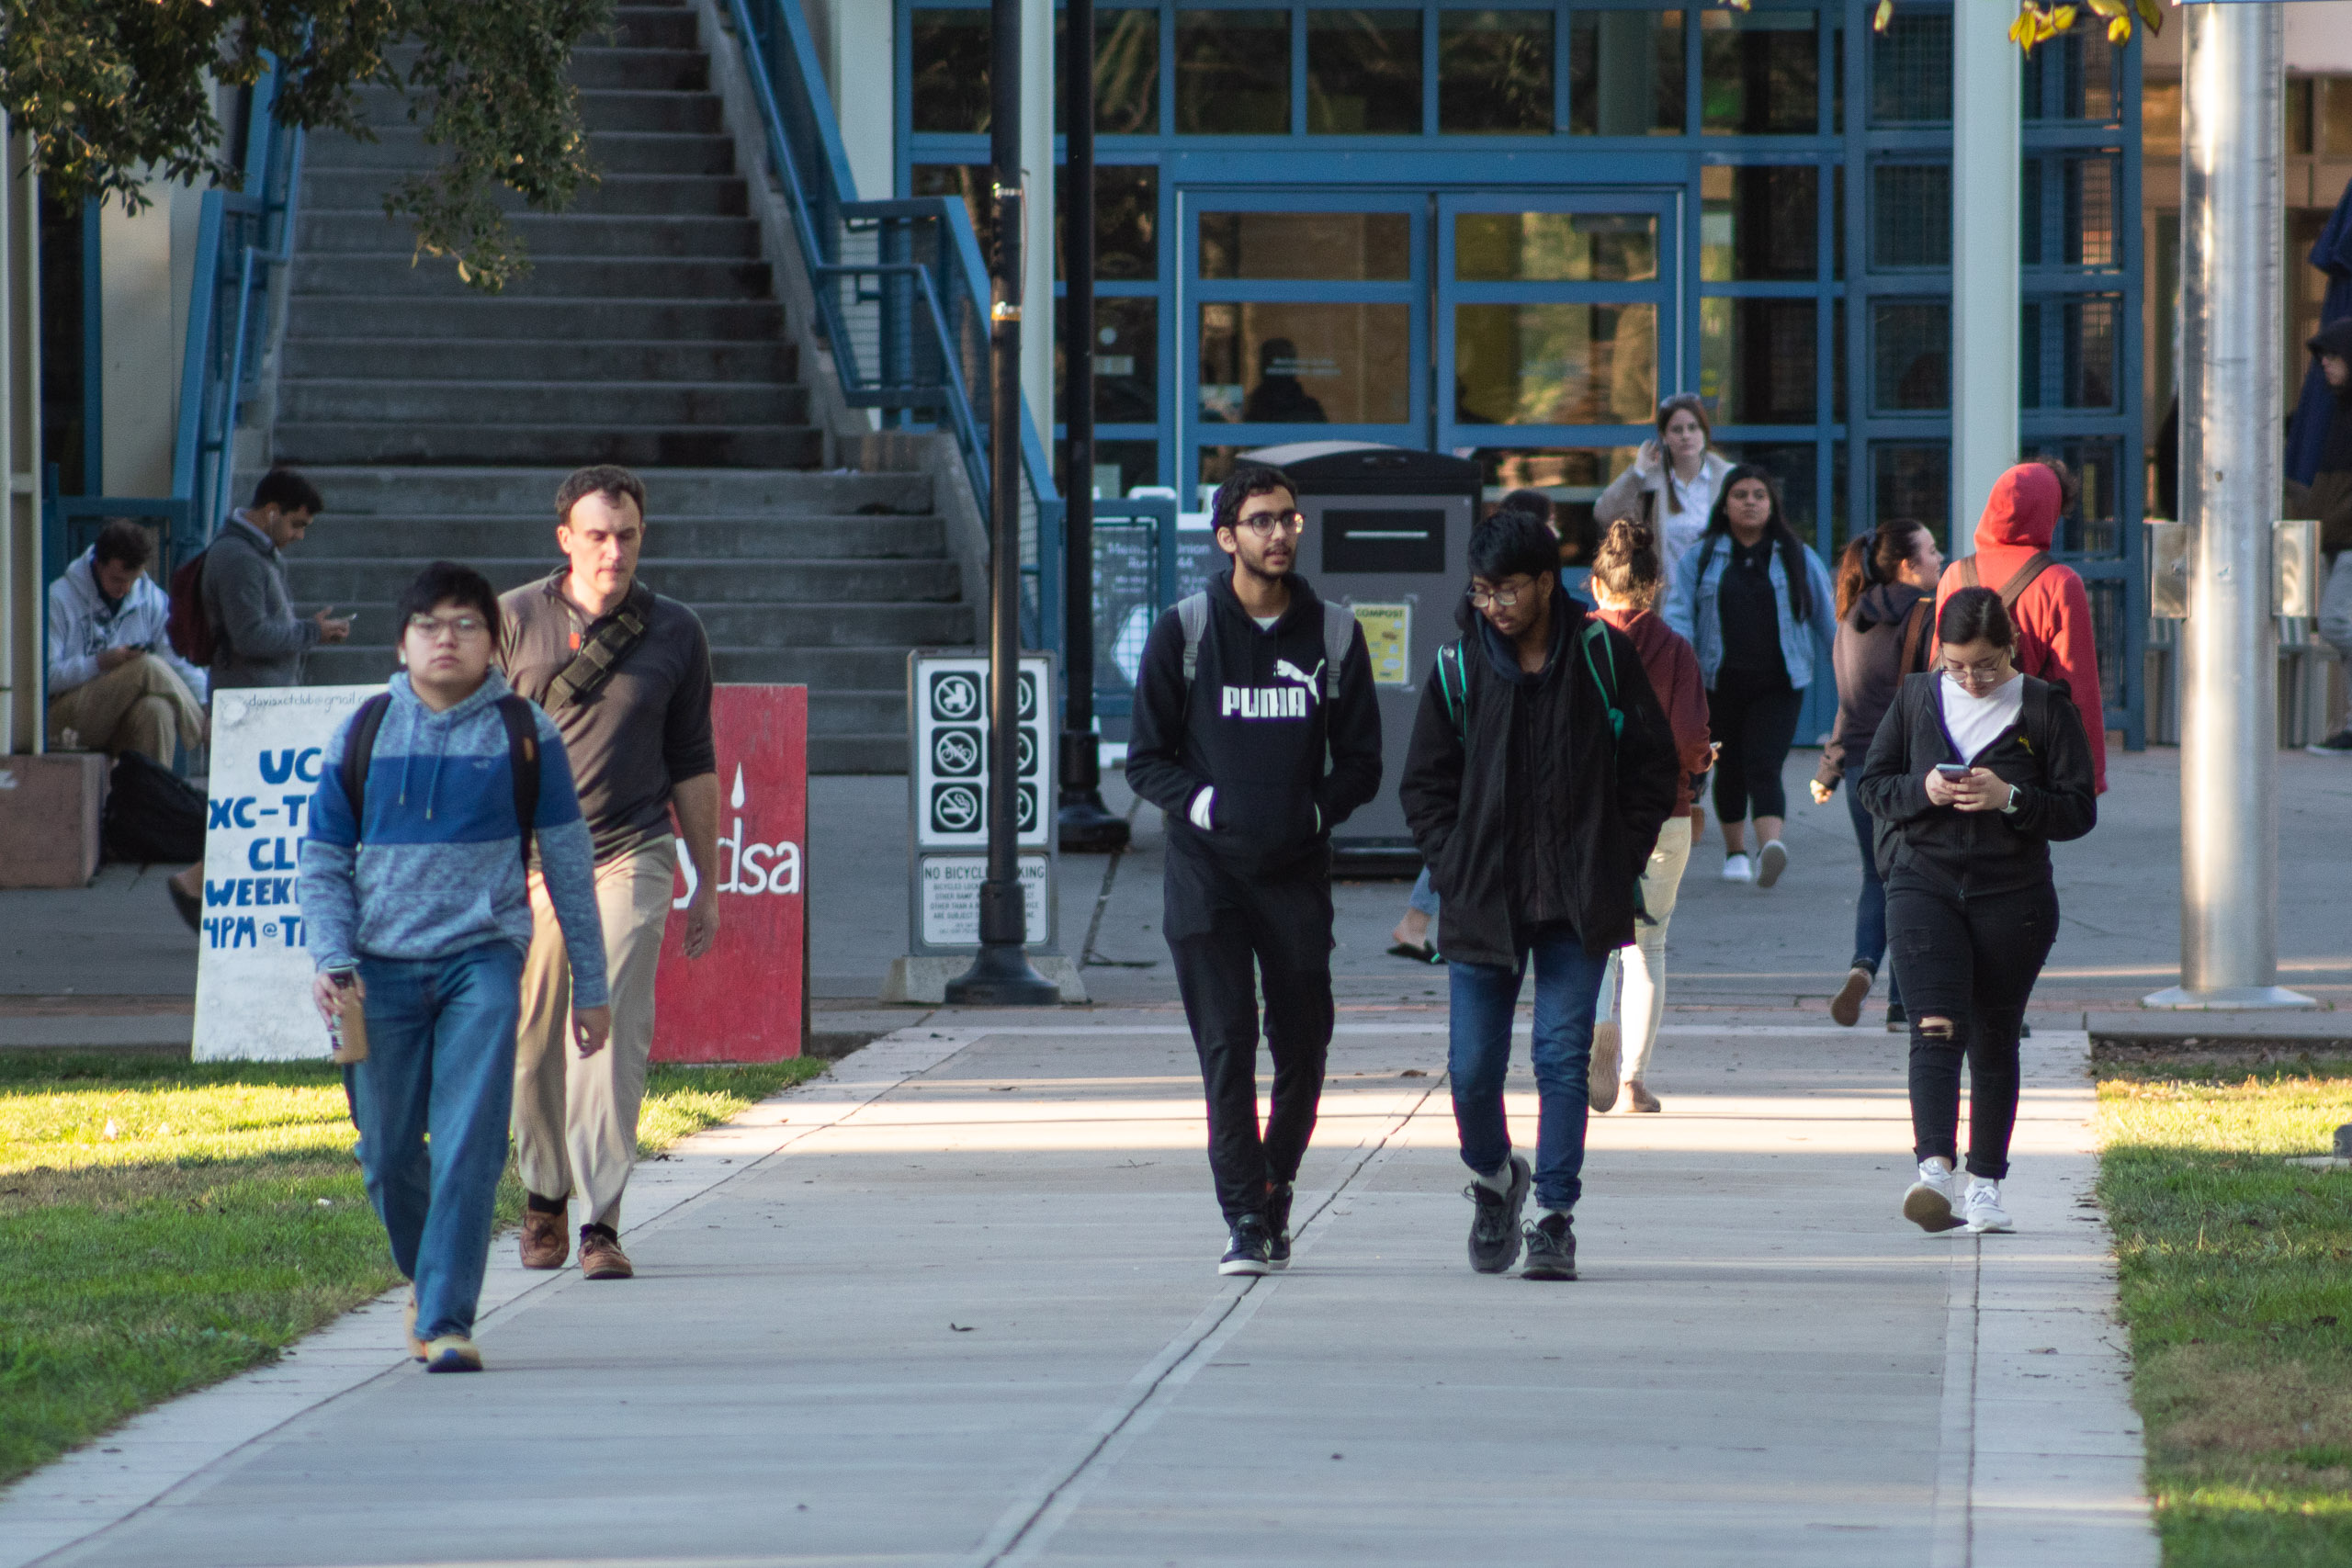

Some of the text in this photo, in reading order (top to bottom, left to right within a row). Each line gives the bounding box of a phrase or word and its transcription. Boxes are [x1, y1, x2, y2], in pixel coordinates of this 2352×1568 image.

[1355, 609, 1404, 618] COMPOST
[1222, 685, 1306, 717] PUMA
[259, 747, 322, 784] UC
[208, 795, 310, 829] XC-T
[924, 866, 941, 880] NO
[1018, 866, 1045, 879] KING
[205, 877, 299, 907] WEEK
